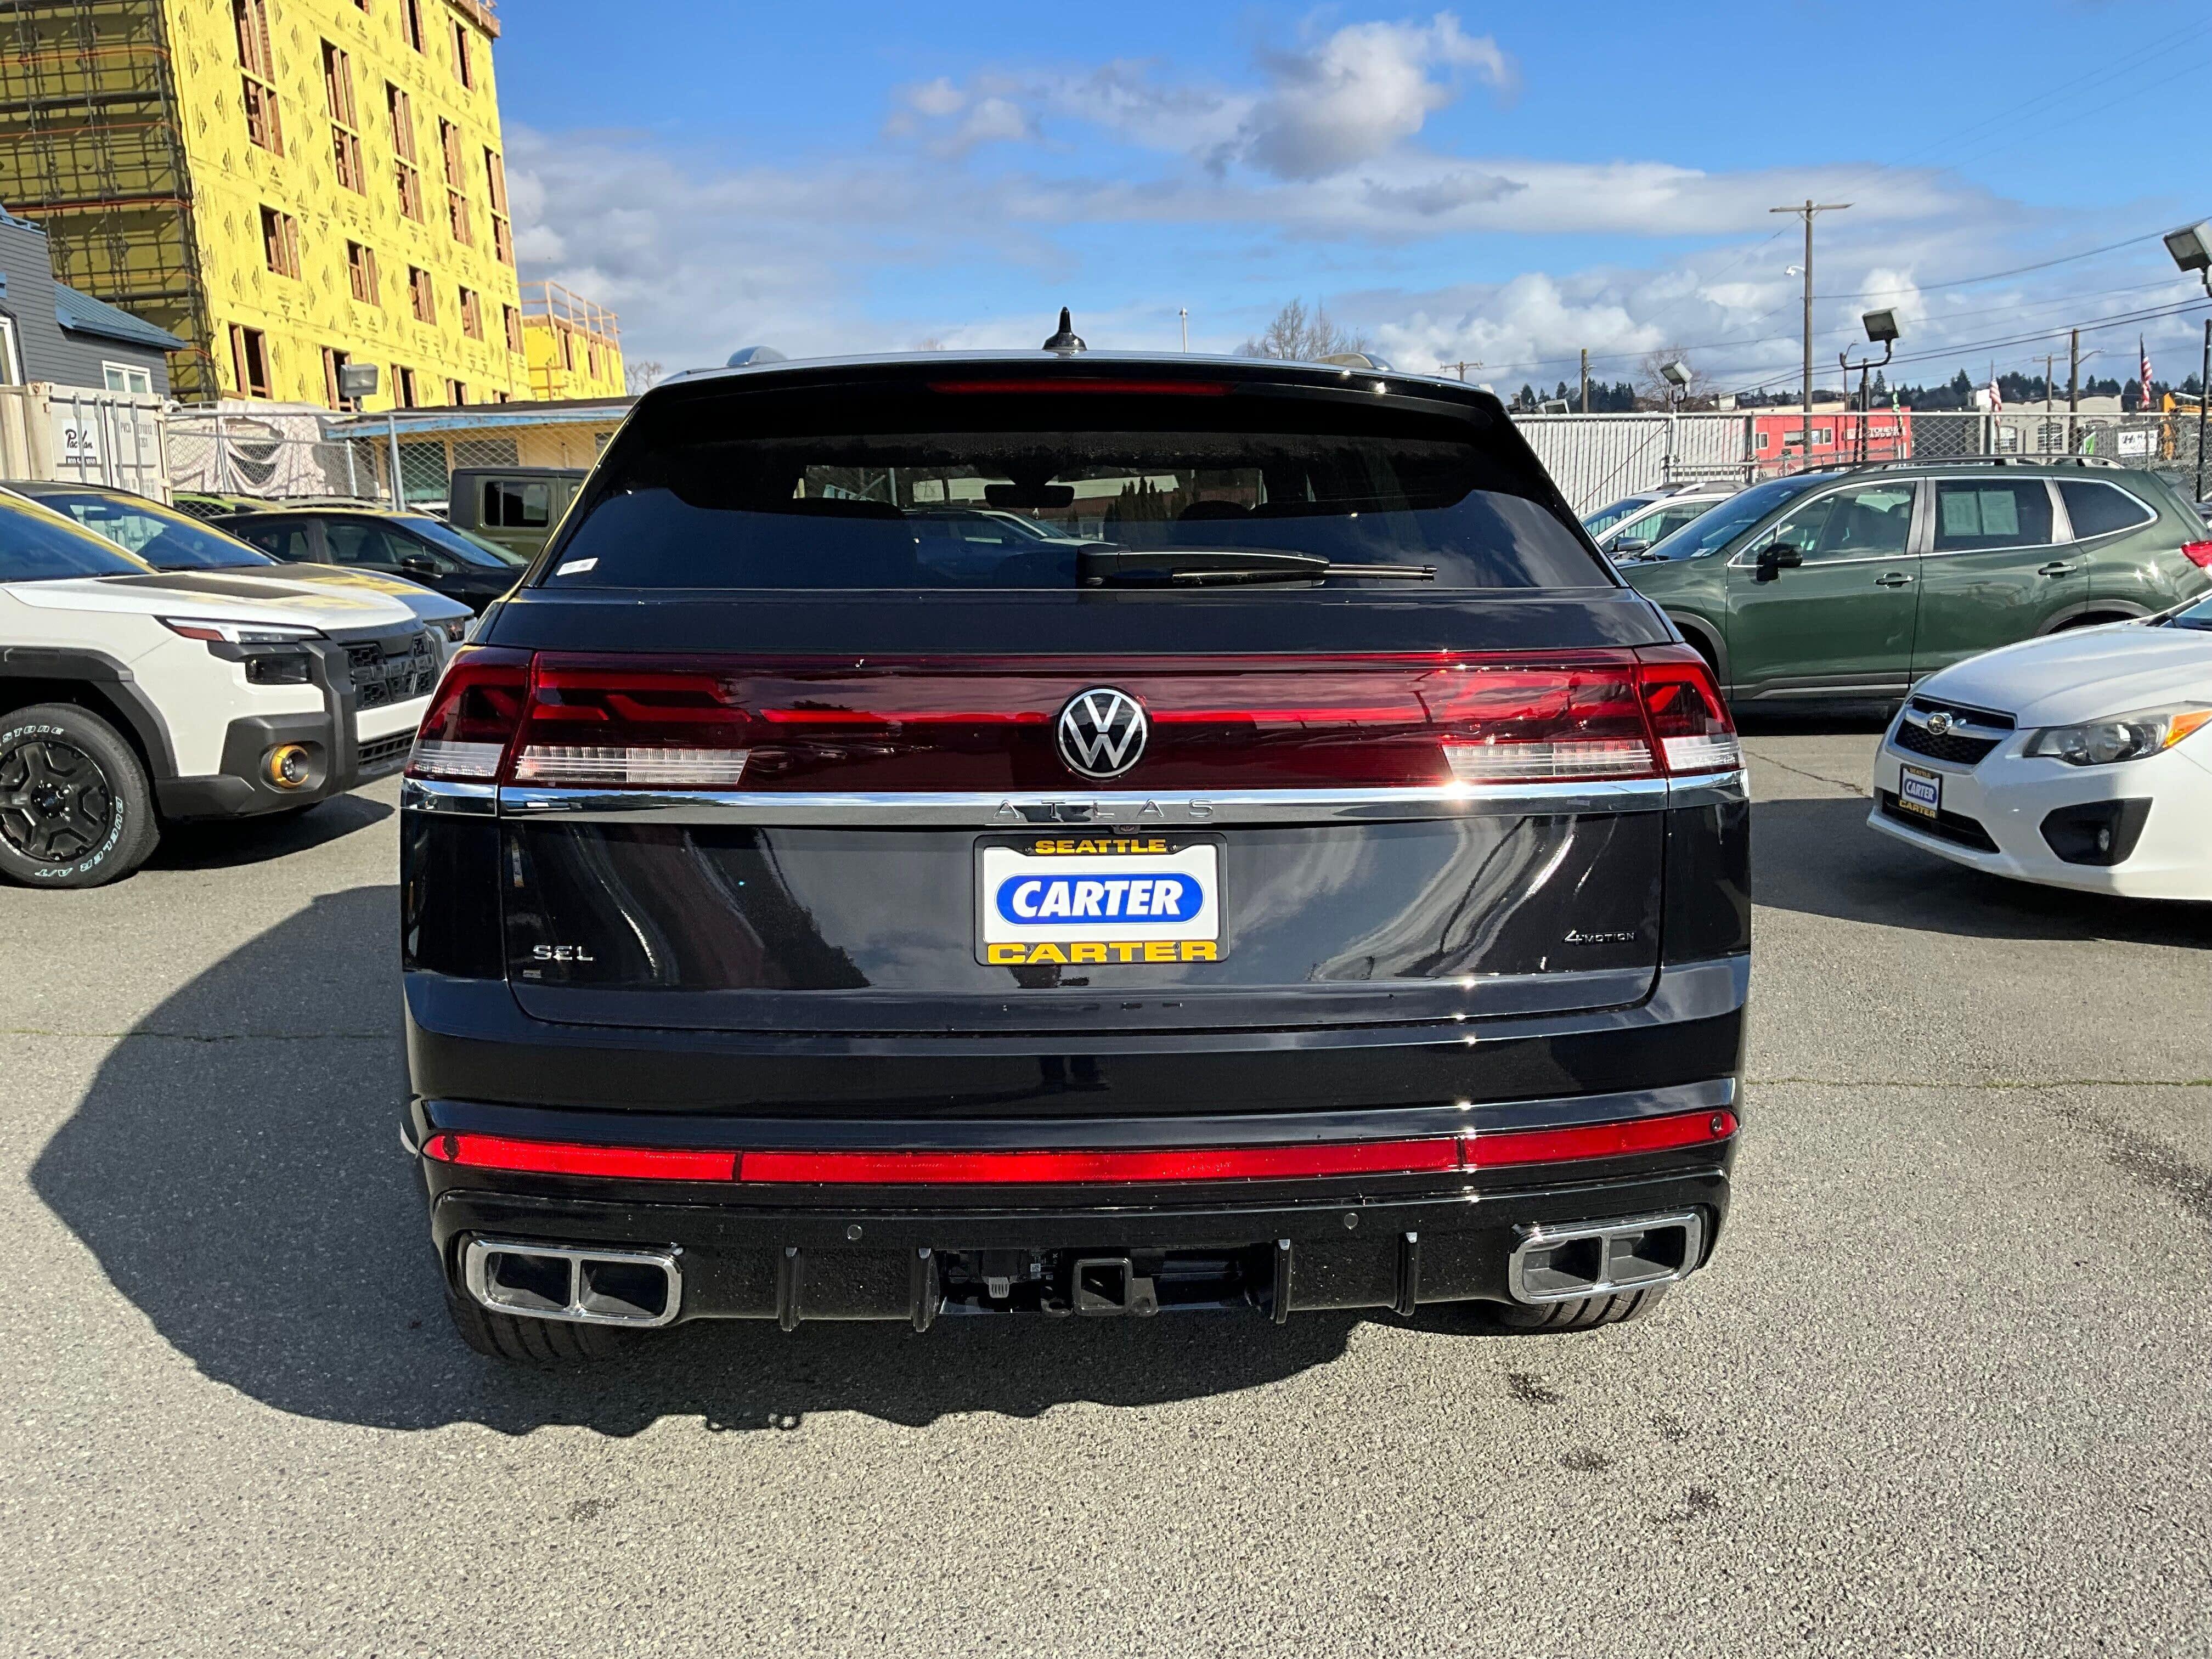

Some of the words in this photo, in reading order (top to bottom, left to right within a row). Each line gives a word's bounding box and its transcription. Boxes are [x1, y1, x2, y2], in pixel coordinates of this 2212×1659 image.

[351, 654, 434, 685] SUBARU
[0, 725, 64, 744] STONE
[1906, 781, 1934, 800] CARTER
[993, 798, 1213, 819] ATLAS
[1899, 799, 1937, 819] CARTER
[1035, 839, 1167, 854] SEATTLE
[1012, 879, 1184, 918] CARTER
[1564, 930, 1635, 945] 4MOTION
[532, 945, 594, 961] SEL
[988, 941, 1218, 964] CARTER
